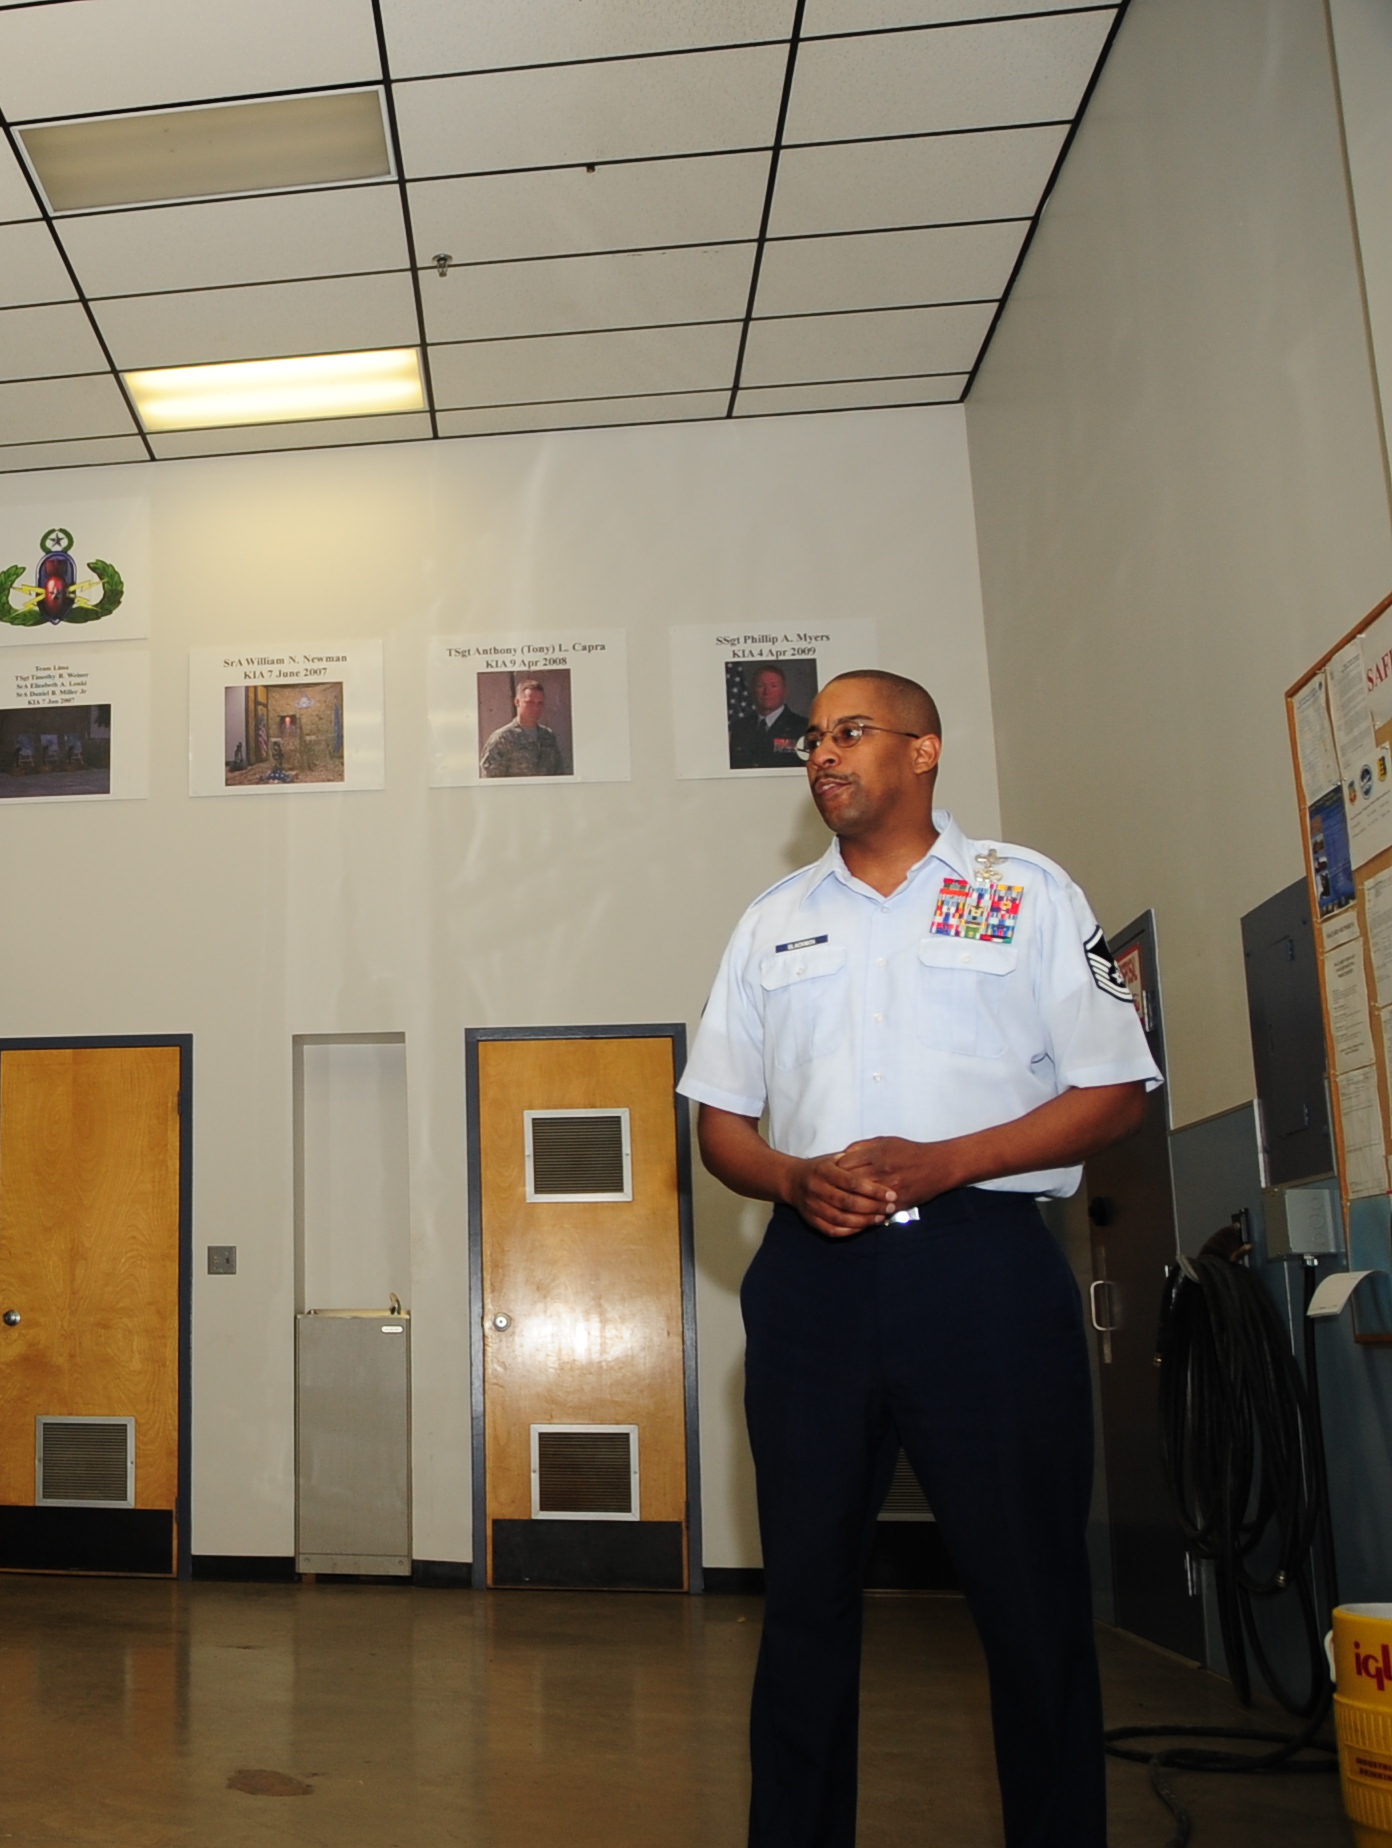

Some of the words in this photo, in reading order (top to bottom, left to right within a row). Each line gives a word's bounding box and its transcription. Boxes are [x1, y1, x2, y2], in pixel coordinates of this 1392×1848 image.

[715, 636, 741, 647] SSgt
[743, 634, 779, 645] Phillip
[781, 633, 793, 643] A.
[796, 632, 831, 644] Myers
[446, 647, 471, 658] TSgt
[474, 645, 518, 657] Anthony
[520, 643, 556, 655] (Tony)
[558, 643, 570, 653] L.
[572, 642, 606, 653] Capra
[732, 648, 755, 658] KIA
[757, 648, 764, 657] 4
[766, 647, 788, 659] Apr
[791, 646, 816, 656] 2009
[223, 657, 243, 668] SrA
[245, 656, 285, 666] William
[288, 655, 300, 664] N.
[303, 653, 348, 663] Newman
[485, 659, 508, 669] KIA
[510, 658, 517, 667] 9
[519, 658, 540, 669] Apr
[542, 656, 568, 666] 2008
[243, 670, 265, 680] KIA
[267, 669, 274, 679] 7
[275, 668, 301, 679] June
[303, 667, 328, 677] 2007
